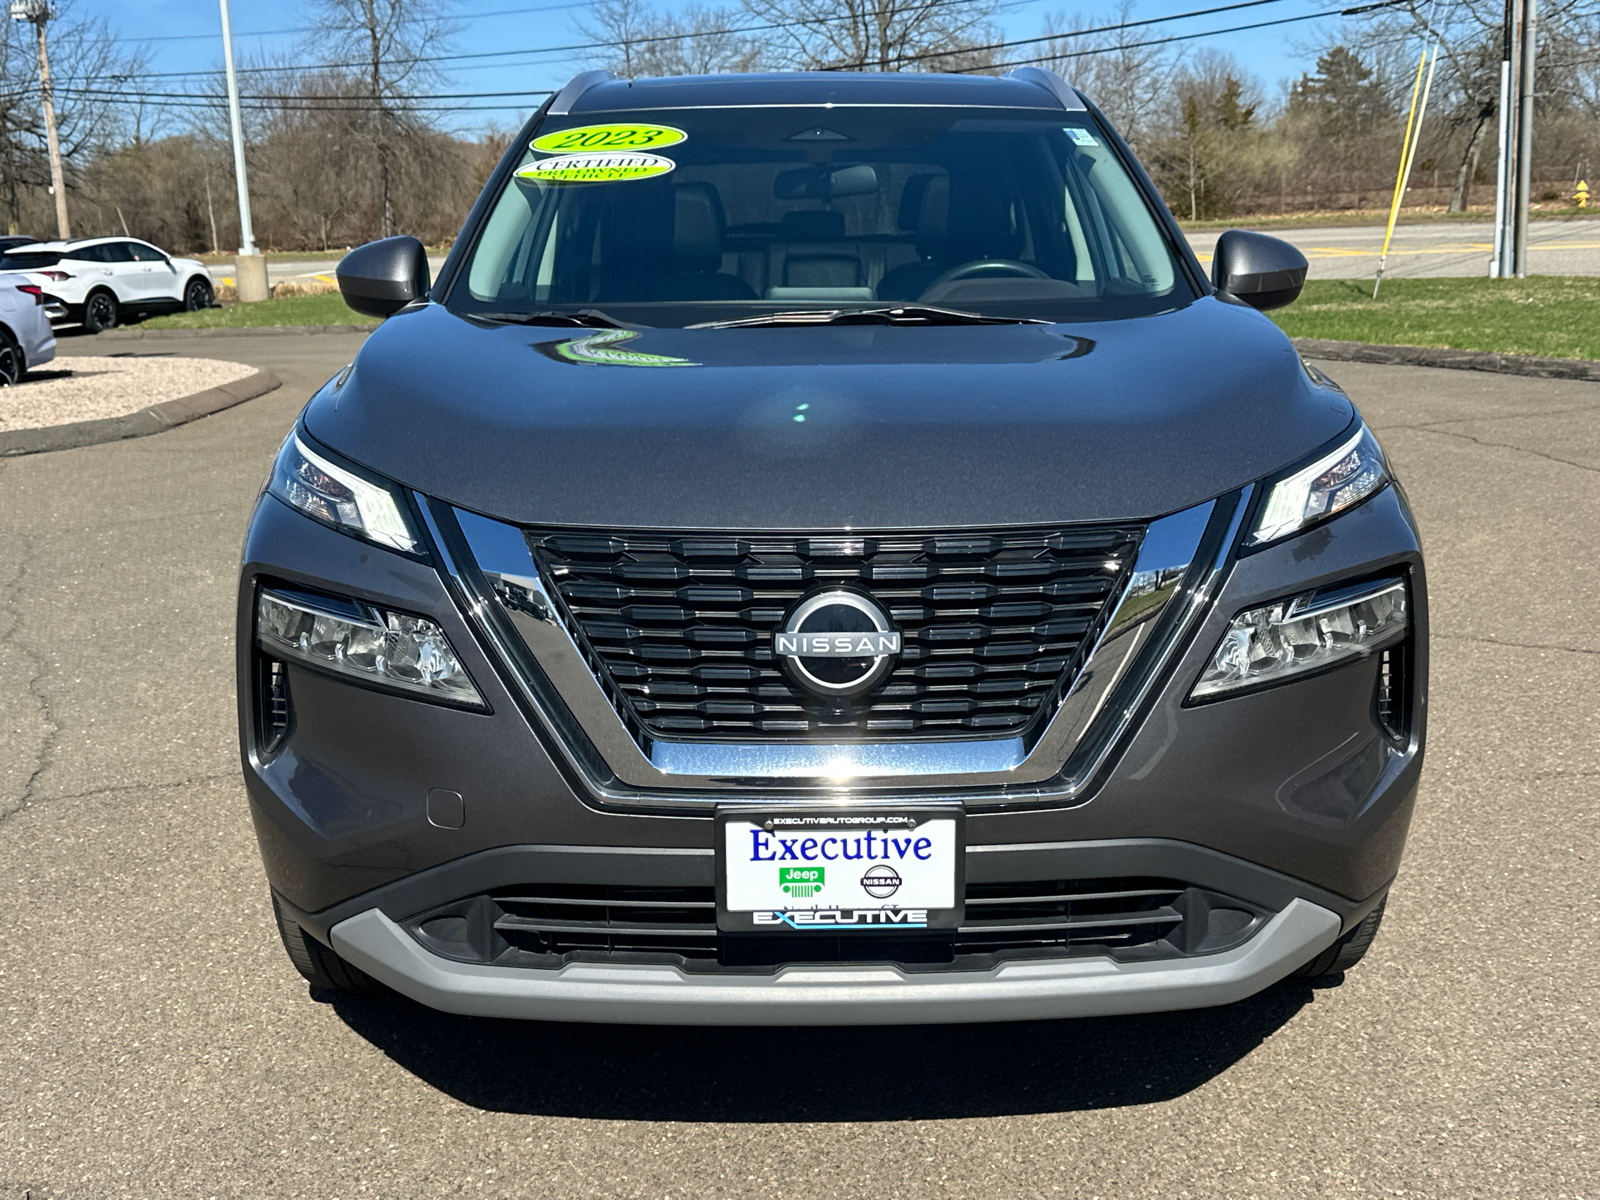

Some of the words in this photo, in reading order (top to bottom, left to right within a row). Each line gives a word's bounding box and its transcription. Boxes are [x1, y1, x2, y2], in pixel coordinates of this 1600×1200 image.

[551, 130, 664, 149] 2023
[536, 158, 659, 171] CERTIFIED
[536, 167, 648, 177] PRE-OWNED
[779, 636, 897, 653] NISSAN
[773, 816, 908, 825] EXECUTIVEAUTOGROUP.COM
[749, 829, 932, 861] Executive
[785, 868, 819, 881] Jeep
[863, 878, 900, 886] NISSAN
[752, 909, 928, 925] EXECUTIVE
